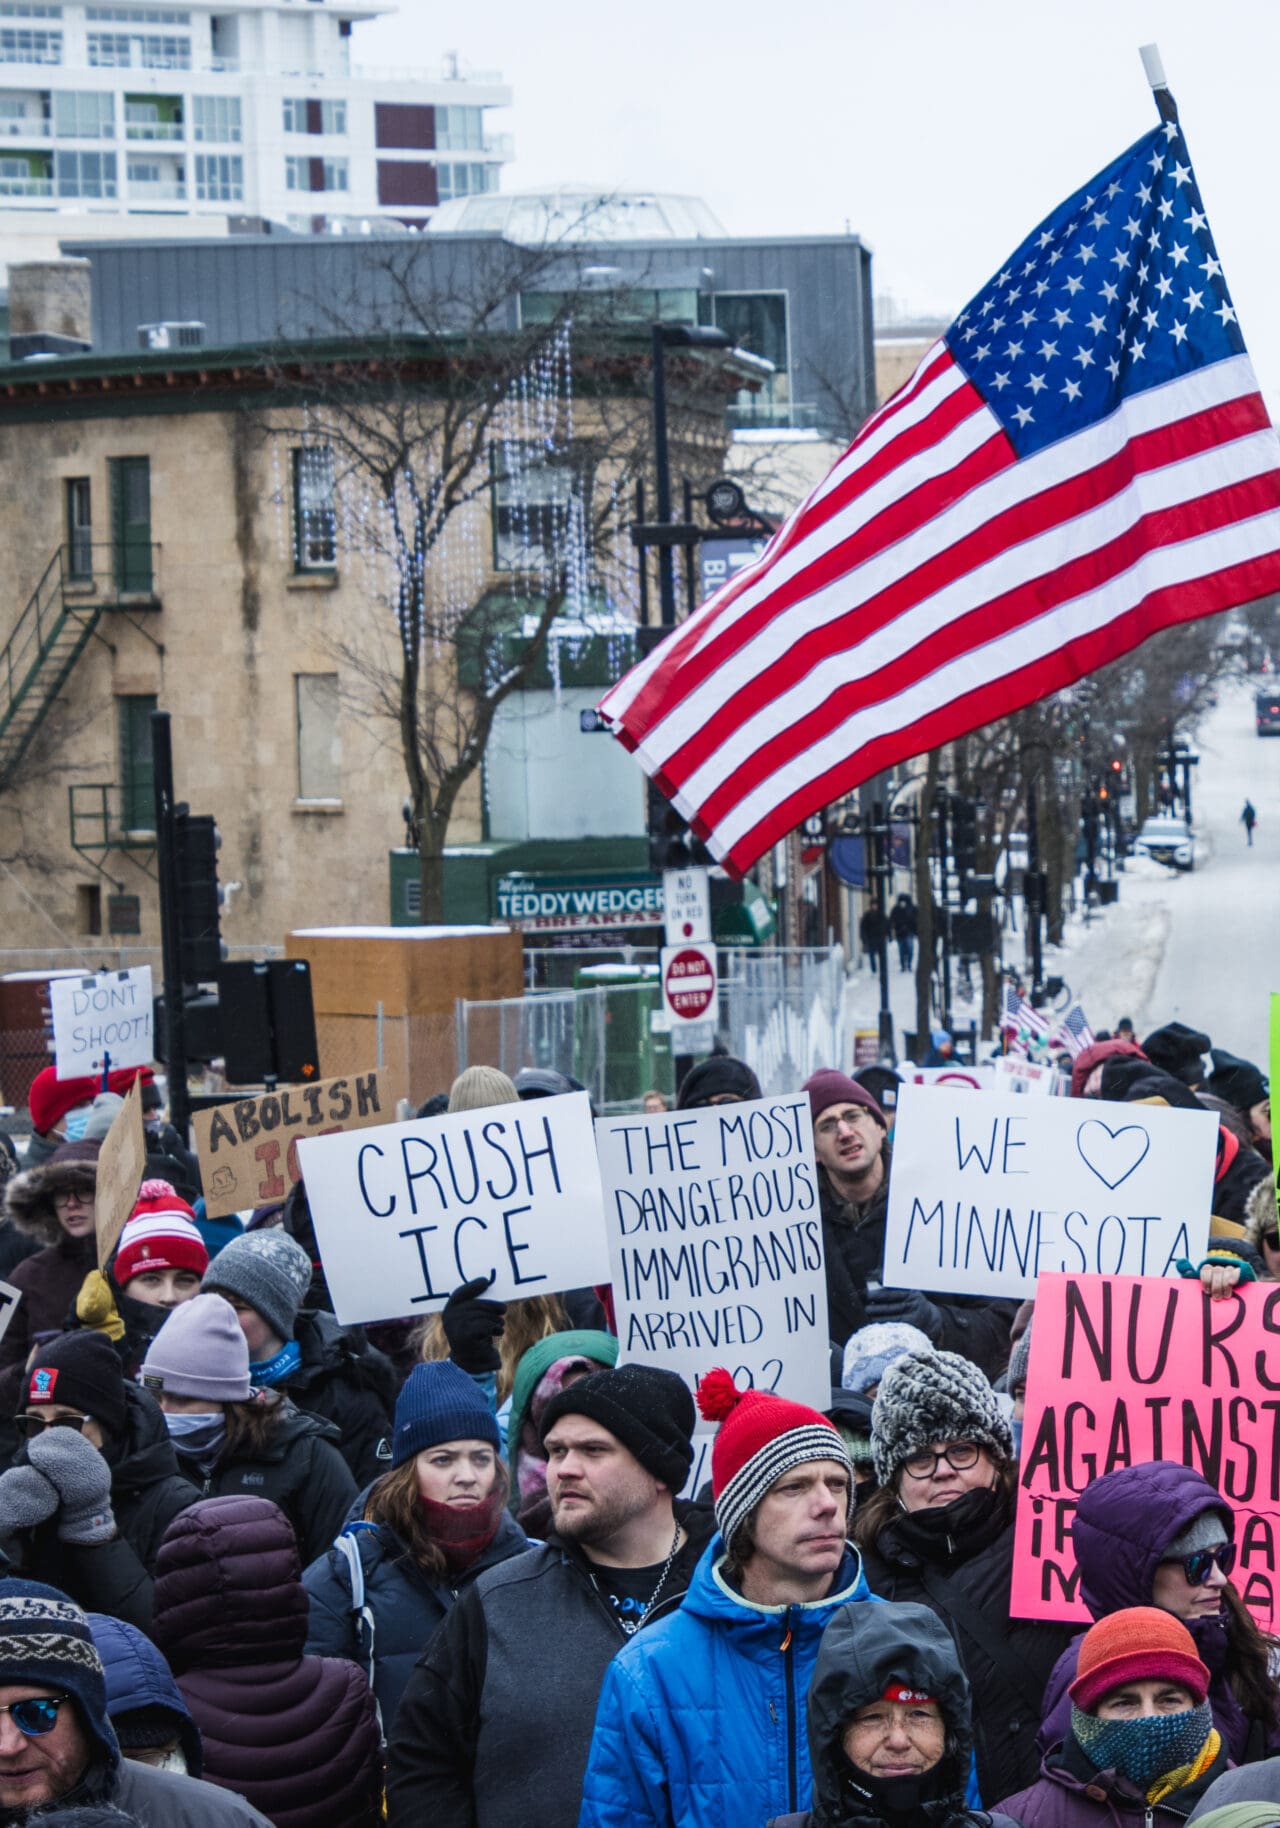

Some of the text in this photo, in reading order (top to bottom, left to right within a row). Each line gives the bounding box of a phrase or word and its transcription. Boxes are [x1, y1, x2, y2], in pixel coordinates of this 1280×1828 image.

[672, 906, 703, 919] ON RED
[674, 893, 697, 903] TURN
[678, 878, 692, 889] NO
[672, 960, 706, 975] DO NOT
[73, 984, 137, 1016] DONT
[673, 993, 708, 1009] ENTER
[73, 1012, 150, 1053] SHOOT!
[210, 1073, 381, 1153] ABOLISH
[610, 1102, 807, 1175] THE MOST
[358, 1116, 562, 1218] CRUSH
[956, 1116, 1030, 1174] WE
[614, 1162, 815, 1235] DANGEROUS
[398, 1205, 547, 1304] ICE
[620, 1220, 821, 1301] IMMIGRANTS
[903, 1197, 1190, 1278] MINNESOTA
[627, 1294, 816, 1352] ARRIVED IN
